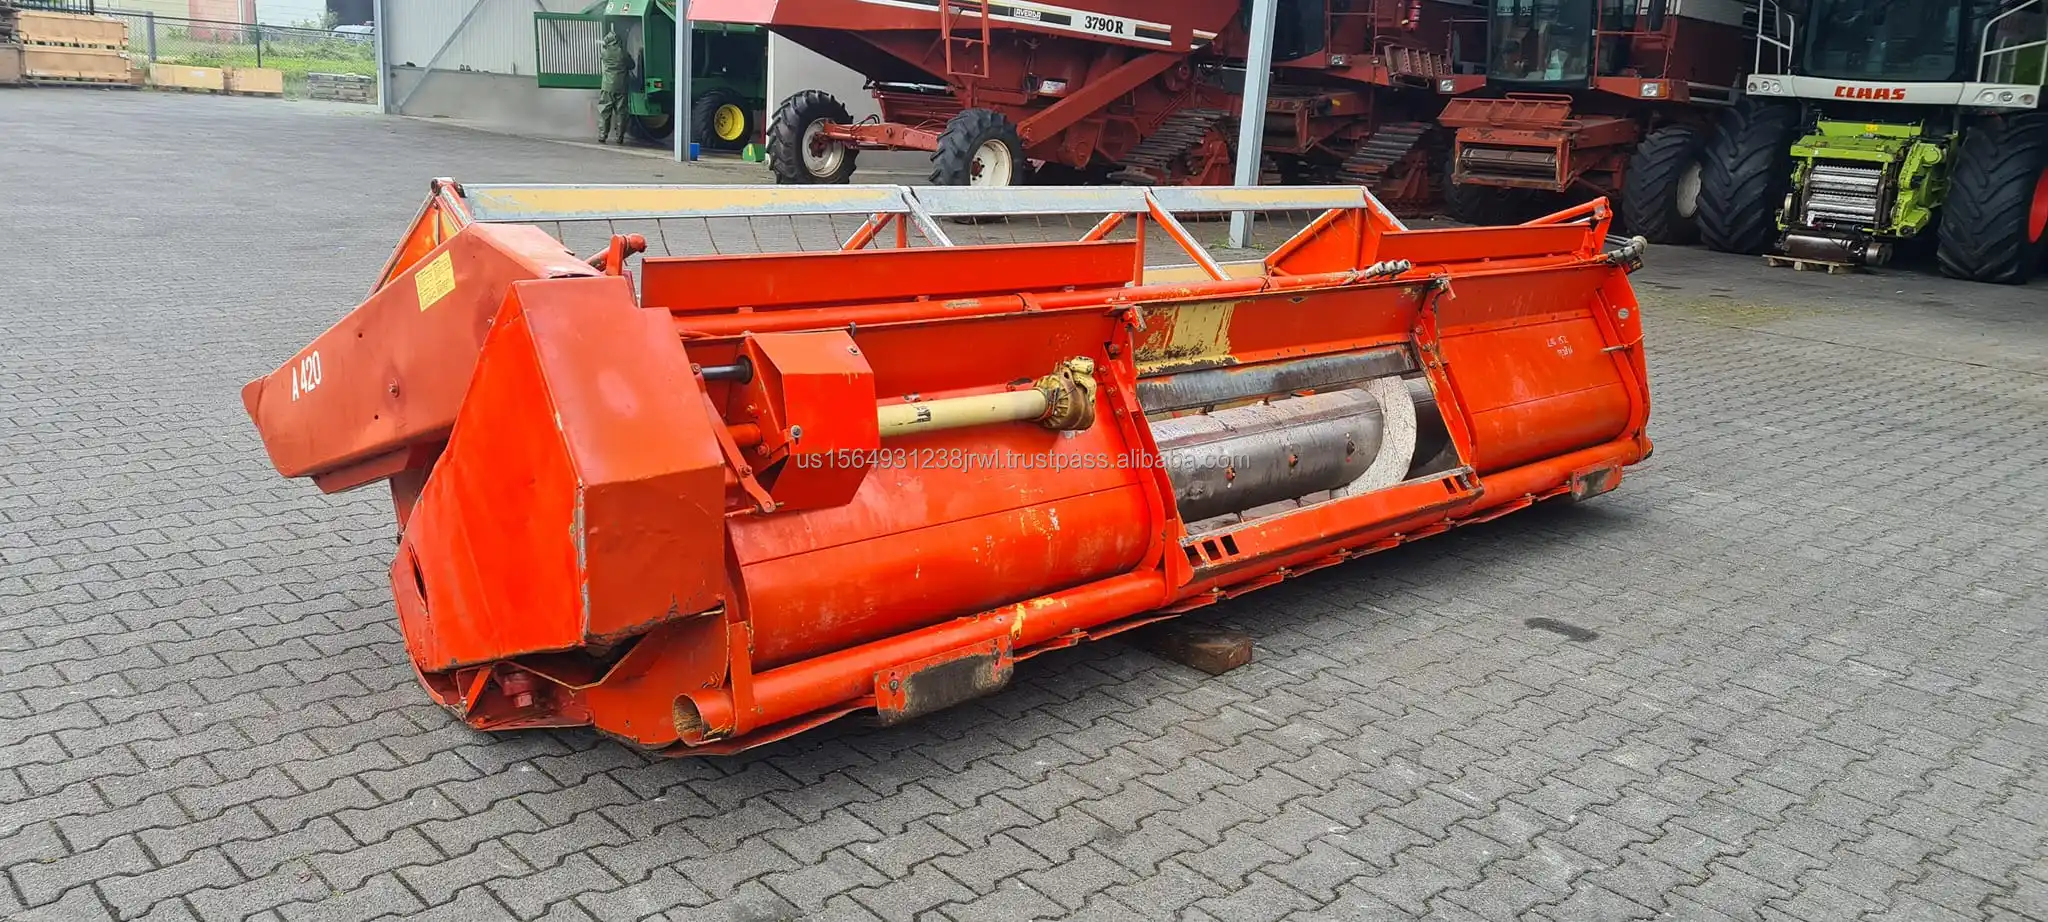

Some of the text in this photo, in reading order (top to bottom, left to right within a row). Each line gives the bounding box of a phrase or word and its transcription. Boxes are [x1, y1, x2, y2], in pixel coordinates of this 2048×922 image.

[1084, 16, 1124, 34] 3790R
[1834, 86, 1906, 100] CLAAS
[292, 350, 321, 401] A 420
